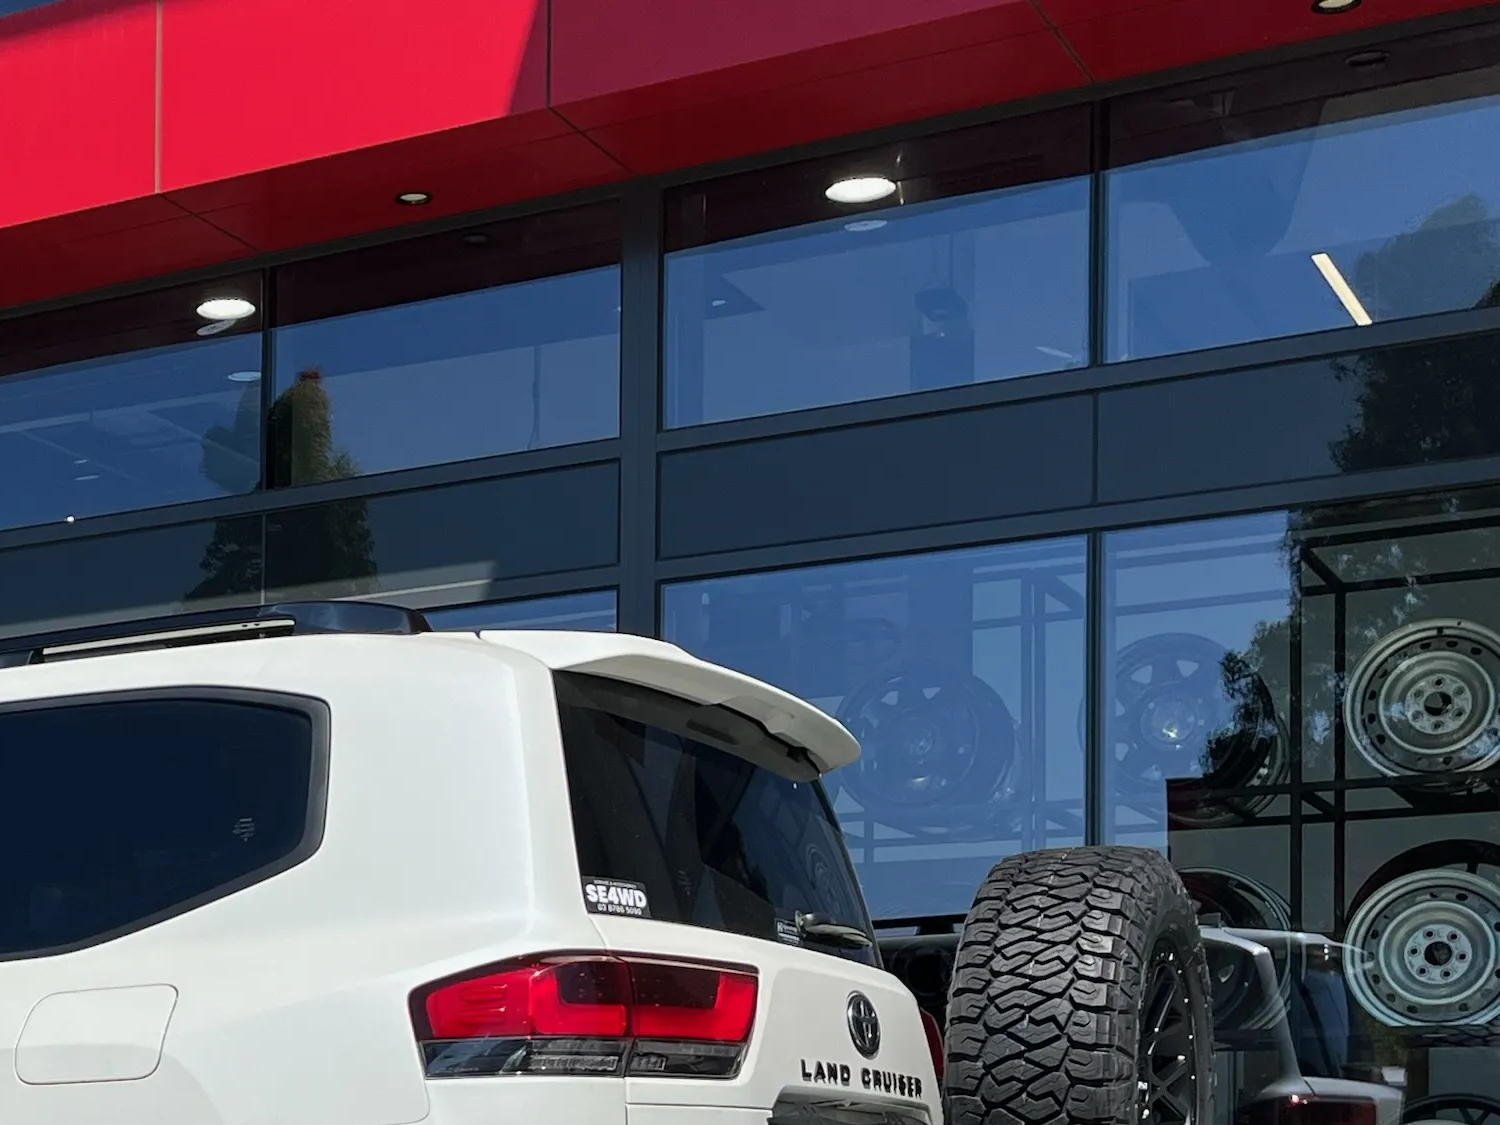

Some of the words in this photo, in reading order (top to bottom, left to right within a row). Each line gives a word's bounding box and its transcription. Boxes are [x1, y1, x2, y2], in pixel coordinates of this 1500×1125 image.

[585, 883, 647, 908] SE4WD
[801, 1058, 851, 1087] LAND
[861, 1067, 922, 1099] CRUISER
